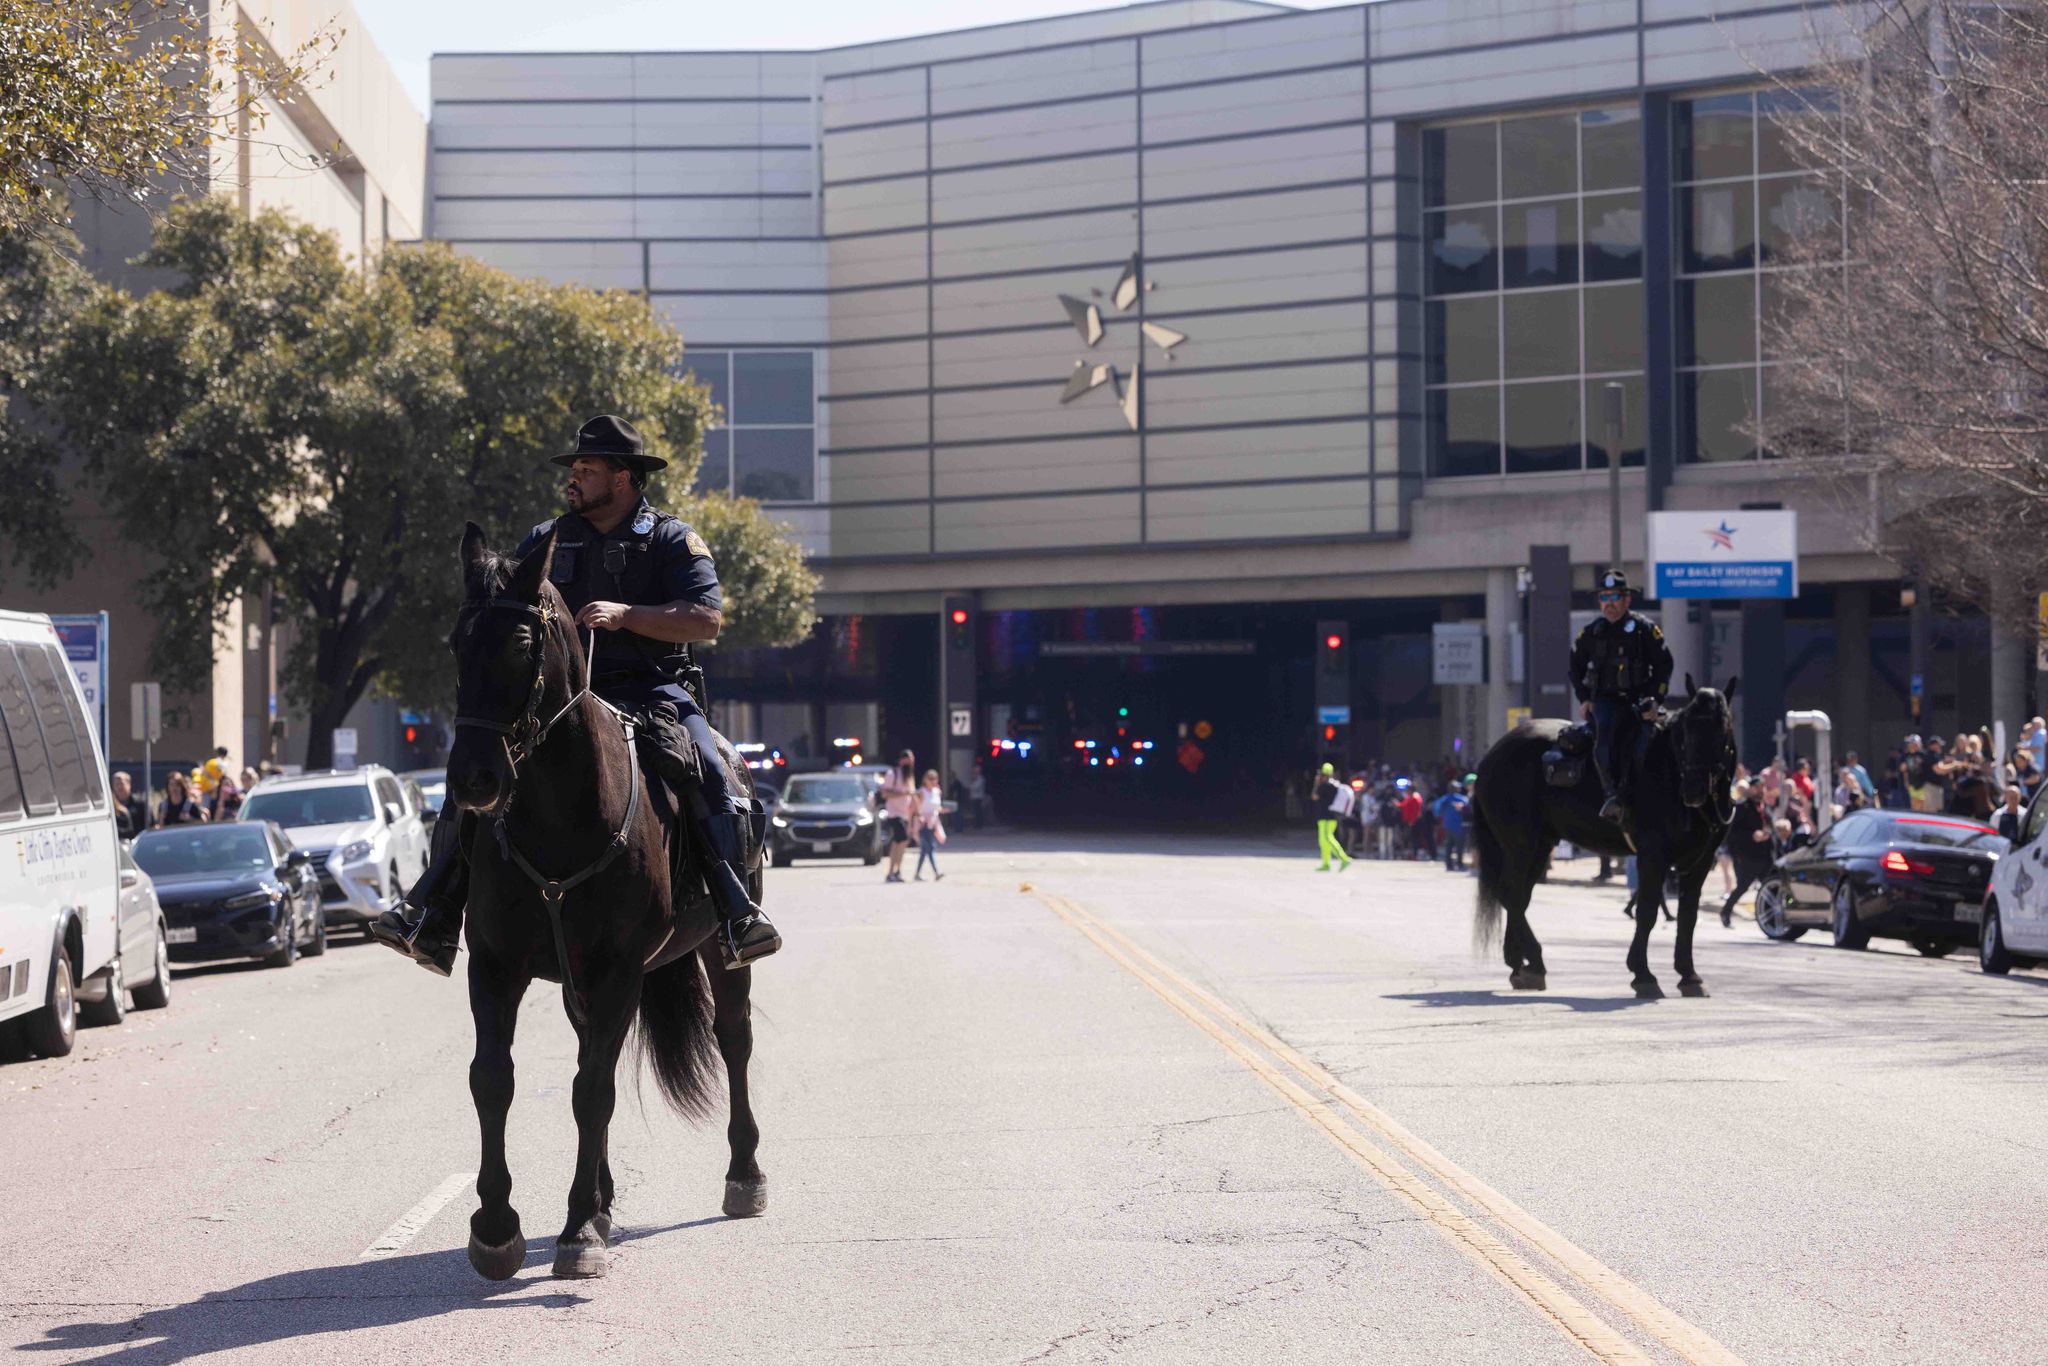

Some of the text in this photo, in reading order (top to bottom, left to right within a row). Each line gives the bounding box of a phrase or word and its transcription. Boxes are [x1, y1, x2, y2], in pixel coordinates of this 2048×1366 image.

[1665, 566, 1783, 577] KAY BAILEY HUTCHISON
